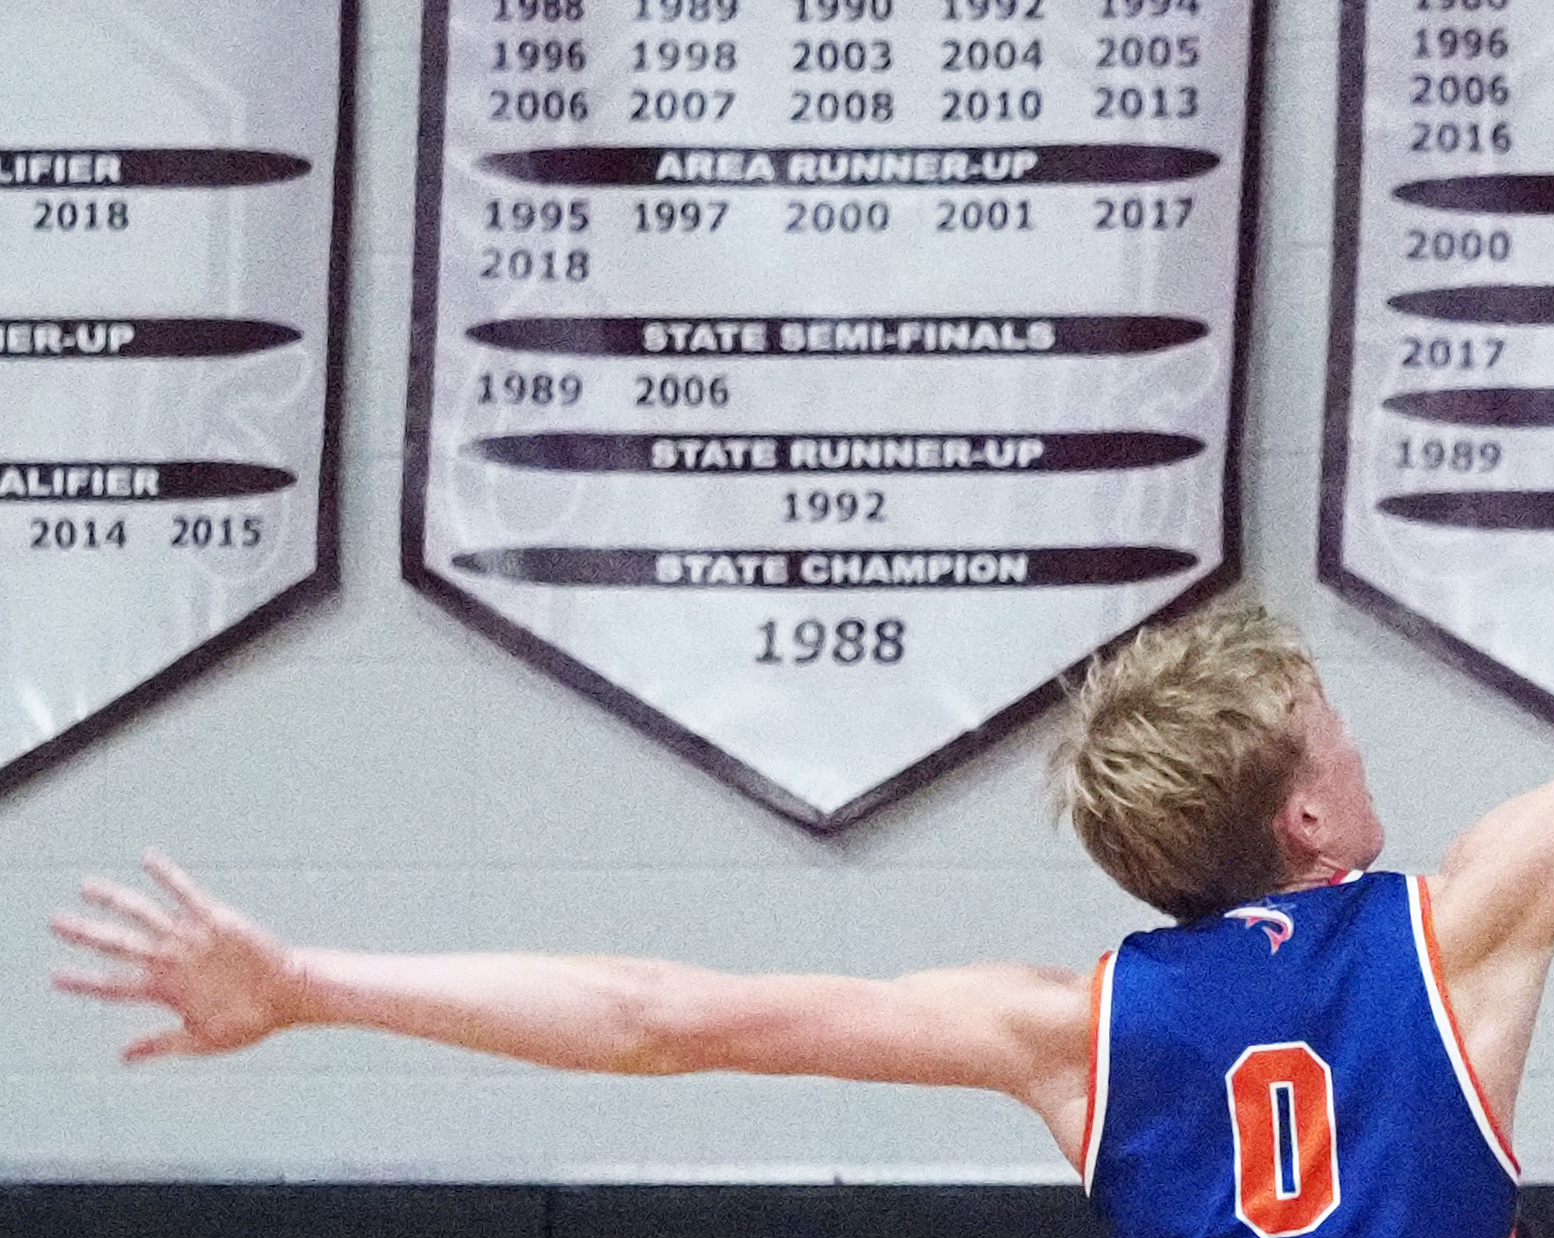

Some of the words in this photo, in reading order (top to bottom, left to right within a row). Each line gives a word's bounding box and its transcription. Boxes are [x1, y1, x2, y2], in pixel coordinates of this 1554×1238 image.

[492, 37, 588, 74] 1996
[631, 38, 739, 74] 1998
[791, 38, 894, 74] 2003
[940, 37, 1044, 73] 2004
[1095, 34, 1202, 70] 2005
[1414, 25, 1510, 61] 1996
[489, 87, 591, 124] 2006
[627, 87, 737, 124] 2007
[789, 88, 896, 124] 2008
[940, 87, 1044, 123] 2010
[1094, 84, 1201, 121] 2013
[1410, 72, 1511, 108] 2006
[1408, 119, 1514, 155] 2016
[654, 152, 777, 182] AREA
[788, 150, 1038, 182] RUNNER-UP
[32, 199, 131, 232] 2018
[485, 198, 592, 235] 1995
[633, 199, 730, 234] 1997
[784, 200, 892, 235] 2000
[935, 198, 1033, 233] 2001
[1094, 194, 1198, 232] 2017
[1404, 227, 1513, 263] 2000
[478, 247, 591, 284] 2018
[0, 323, 135, 354] ER-UP
[643, 322, 768, 353] STATE
[779, 322, 1056, 352] SEMI-FINALS
[1399, 335, 1507, 372] 2017
[477, 370, 584, 407] 1989
[634, 373, 731, 409] 2006
[652, 438, 777, 467] STATE
[790, 438, 1045, 467] RUNNER-UP
[1394, 437, 1504, 473] 1989
[783, 489, 887, 524] 1992
[29, 517, 128, 550] 2014
[169, 514, 264, 550] 2015
[655, 555, 788, 584] STATE
[800, 553, 1029, 583] CHAMPION
[754, 616, 908, 667] 1988
